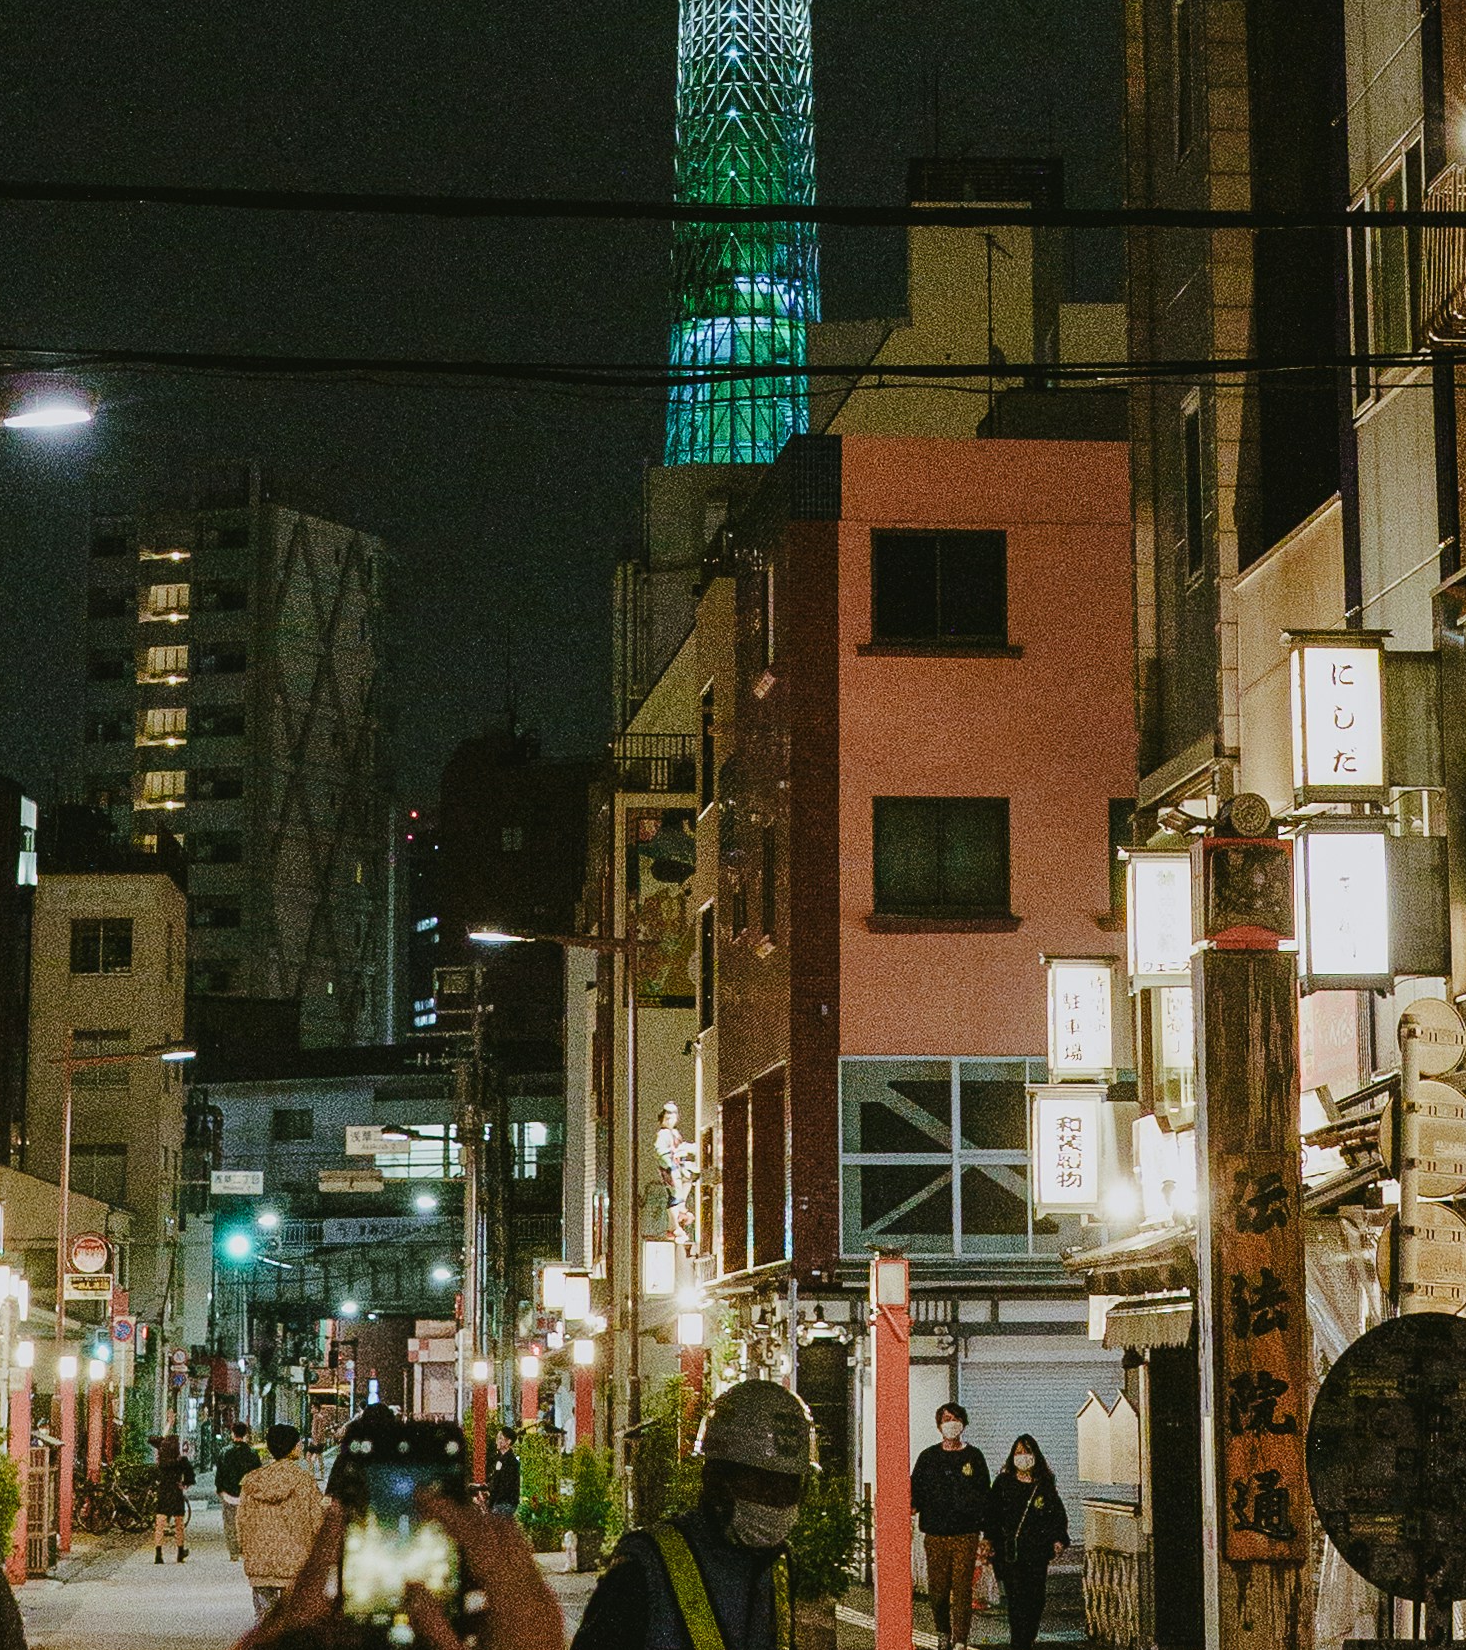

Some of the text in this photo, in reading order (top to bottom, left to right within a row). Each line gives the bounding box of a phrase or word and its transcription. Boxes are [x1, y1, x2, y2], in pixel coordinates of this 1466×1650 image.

[1331, 662, 1359, 774] にしだ
[1063, 992, 1084, 1062] 駐車場
